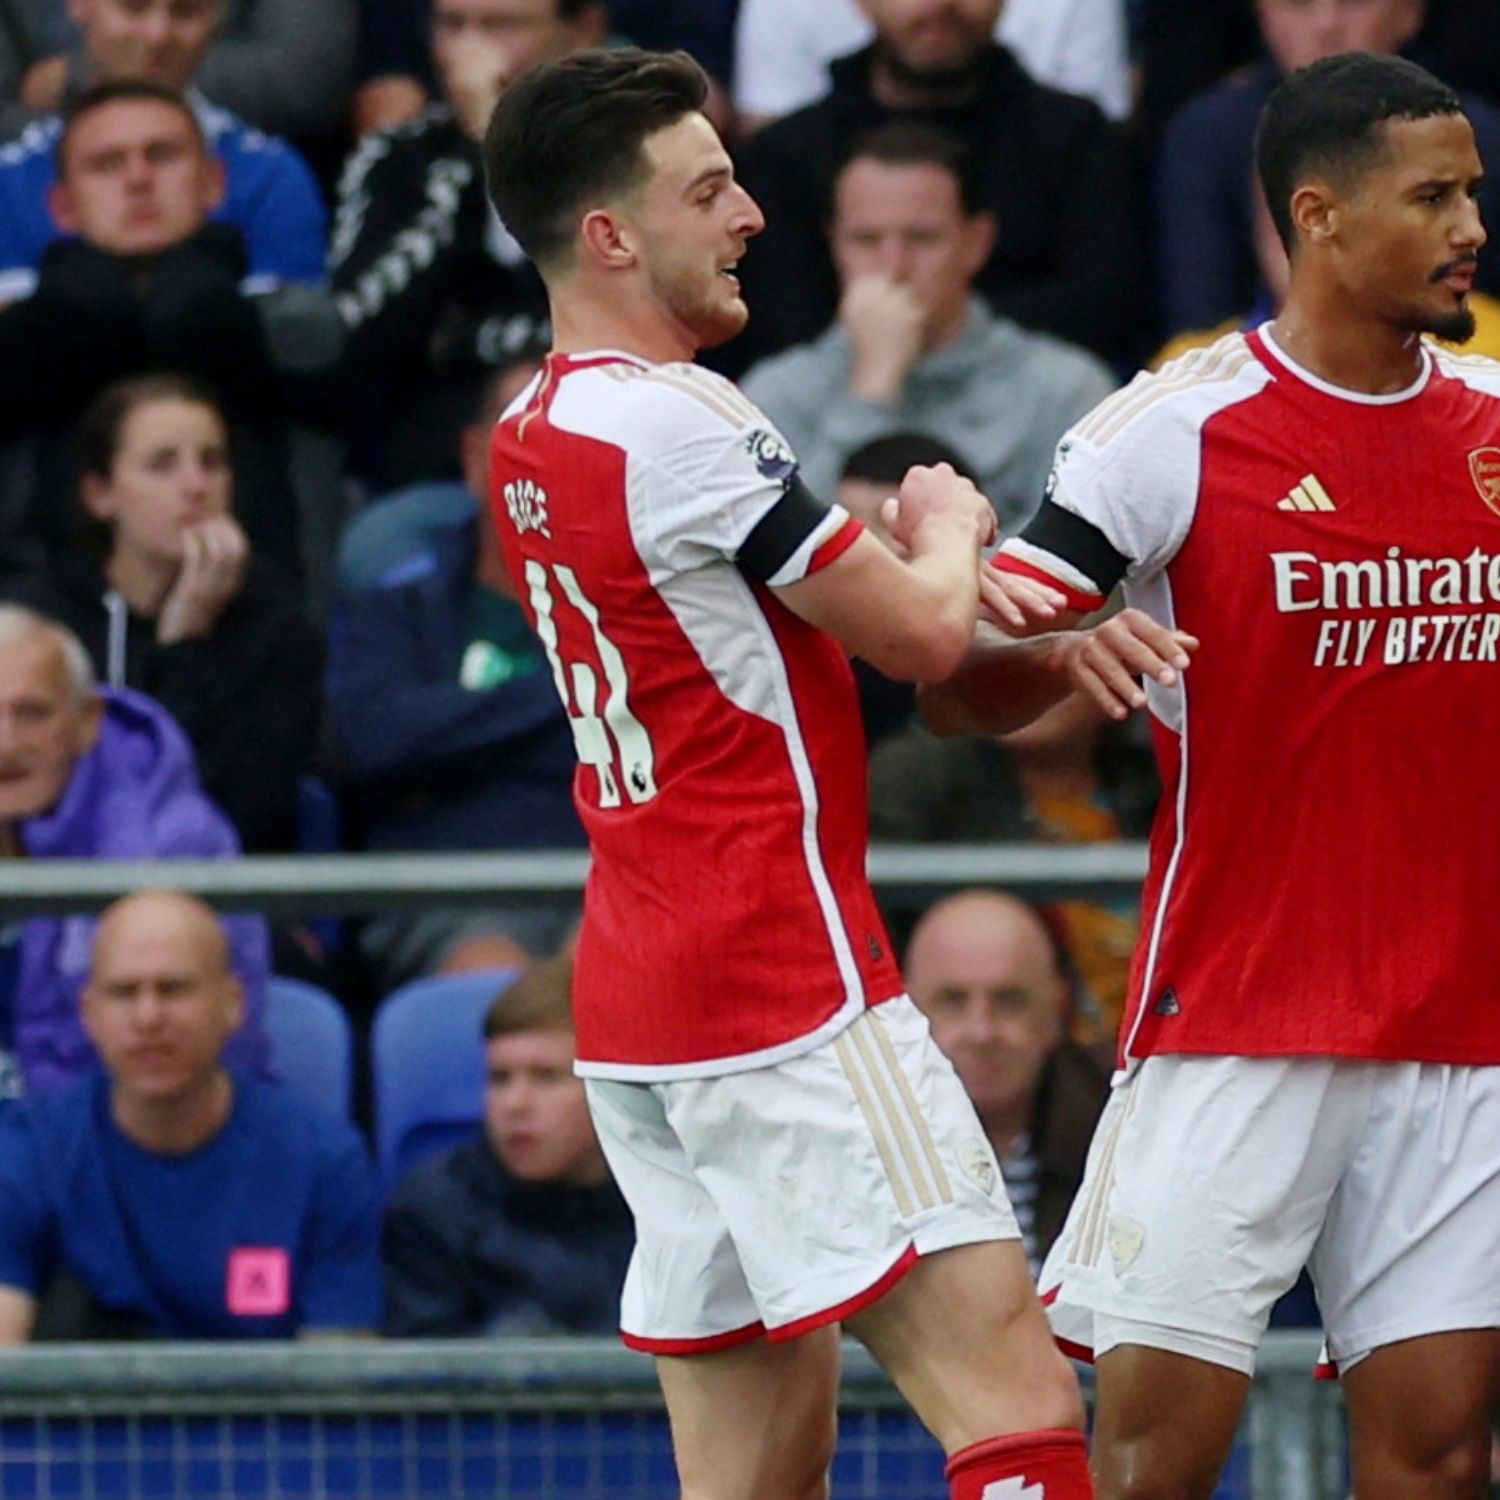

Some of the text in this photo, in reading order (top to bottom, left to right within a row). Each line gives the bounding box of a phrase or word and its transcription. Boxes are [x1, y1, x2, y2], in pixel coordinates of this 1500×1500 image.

[504, 478, 551, 539] RICE
[1313, 619, 1377, 667] FLY
[525, 558, 659, 809] 41
